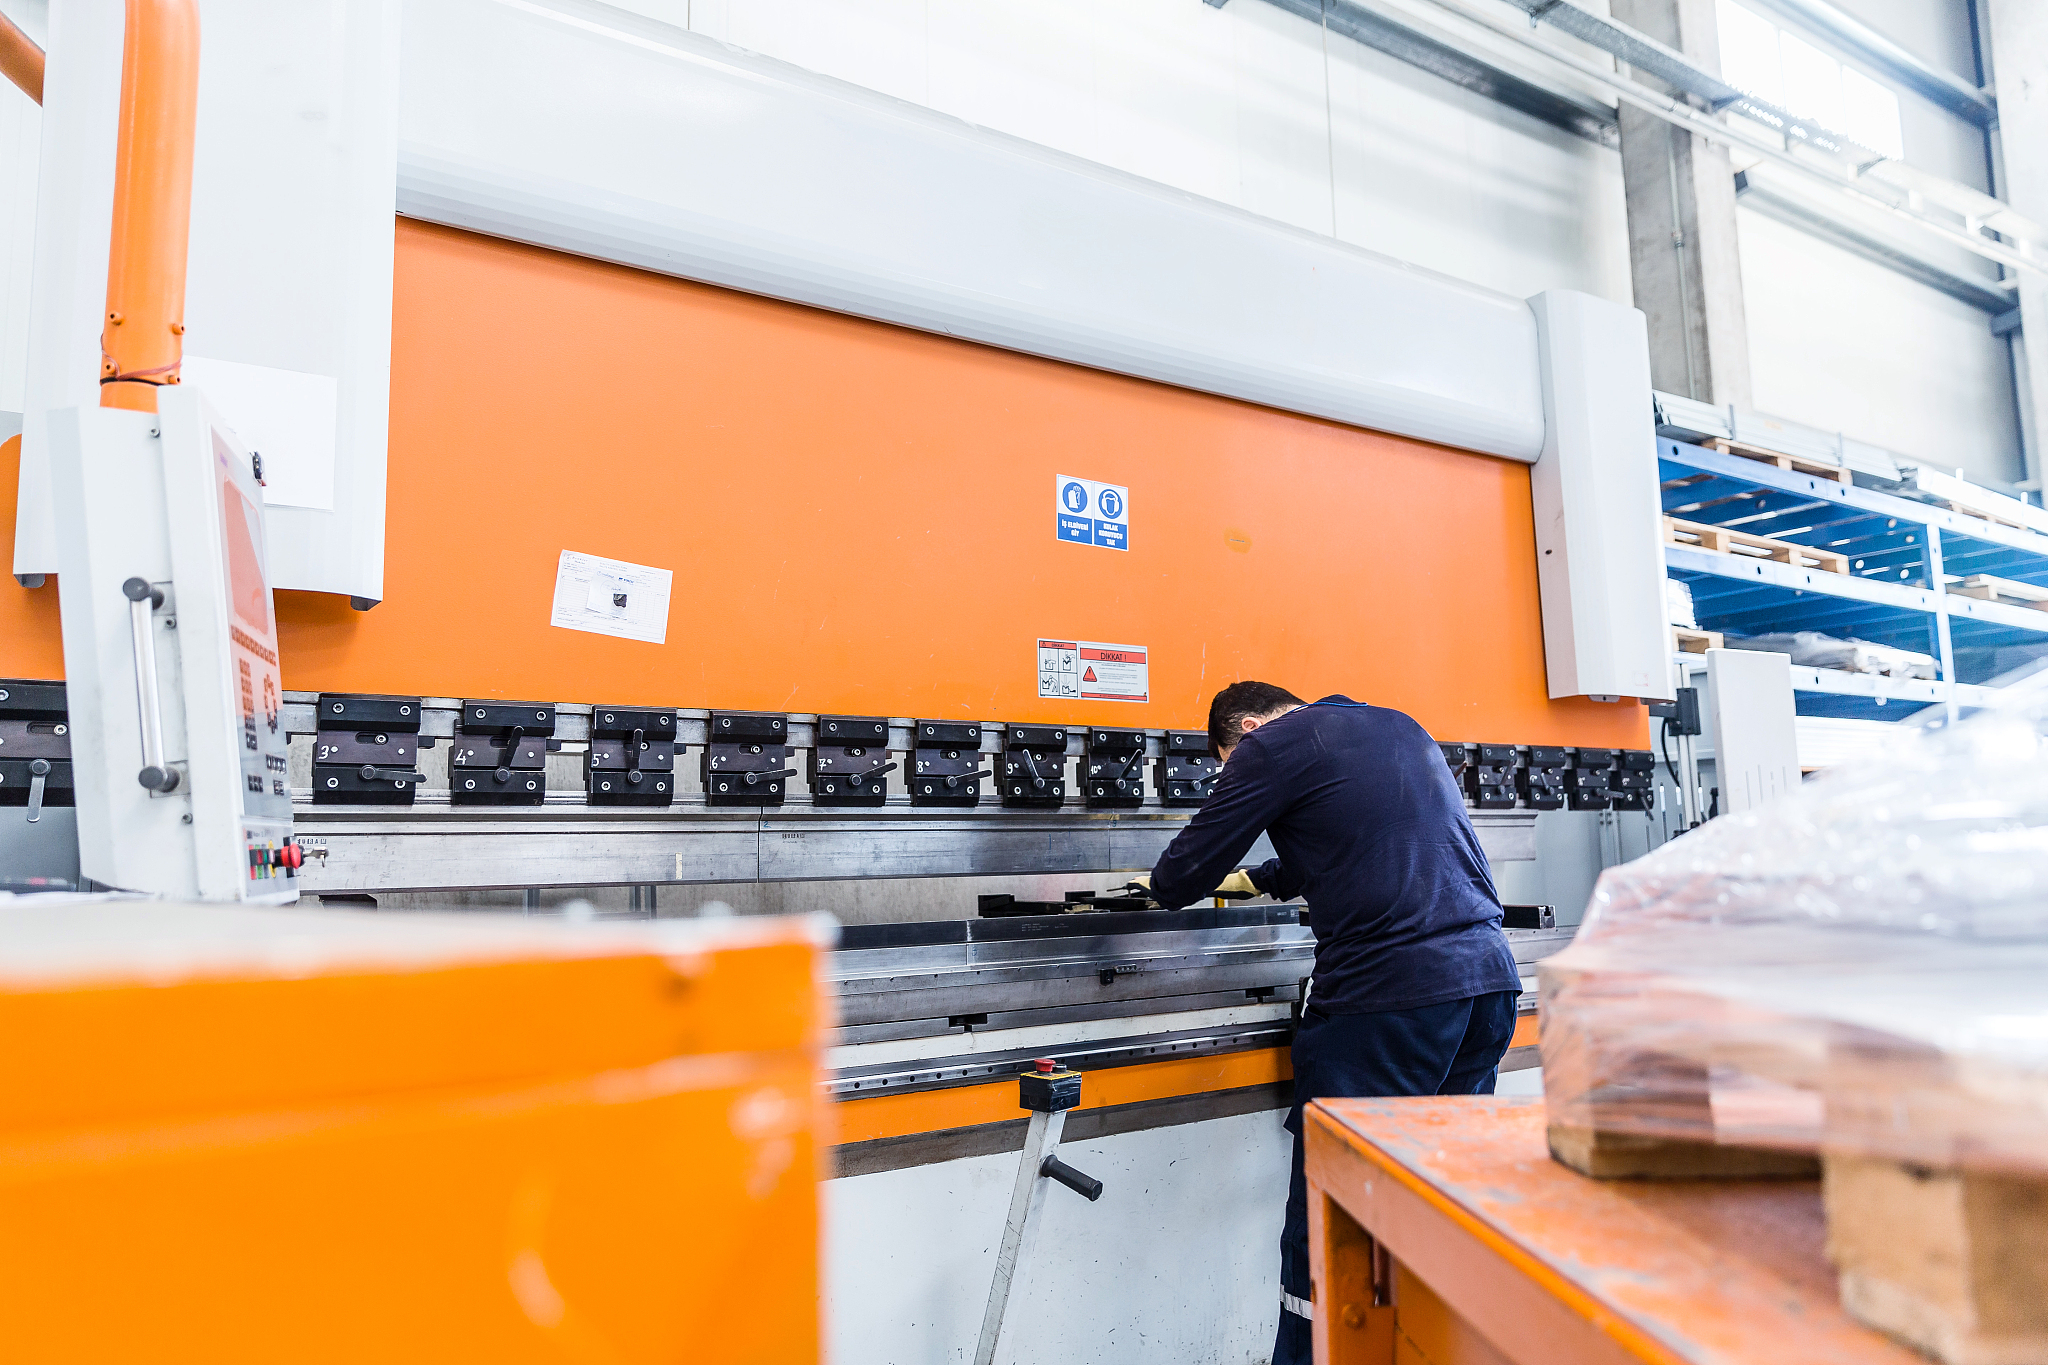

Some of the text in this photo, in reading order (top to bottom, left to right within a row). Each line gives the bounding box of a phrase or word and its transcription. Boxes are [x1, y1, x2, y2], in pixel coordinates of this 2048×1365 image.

[1100, 651, 1123, 661] DİKKAT
[318, 745, 330, 760] 3
[455, 750, 467, 766] 4
[592, 752, 602, 767] 5
[710, 755, 719, 769] 6
[818, 758, 828, 770] 7
[916, 760, 924, 773] 8
[1006, 762, 1014, 775] 9
[1090, 765, 1099, 775] 10
[1167, 768, 1174, 777] 11
